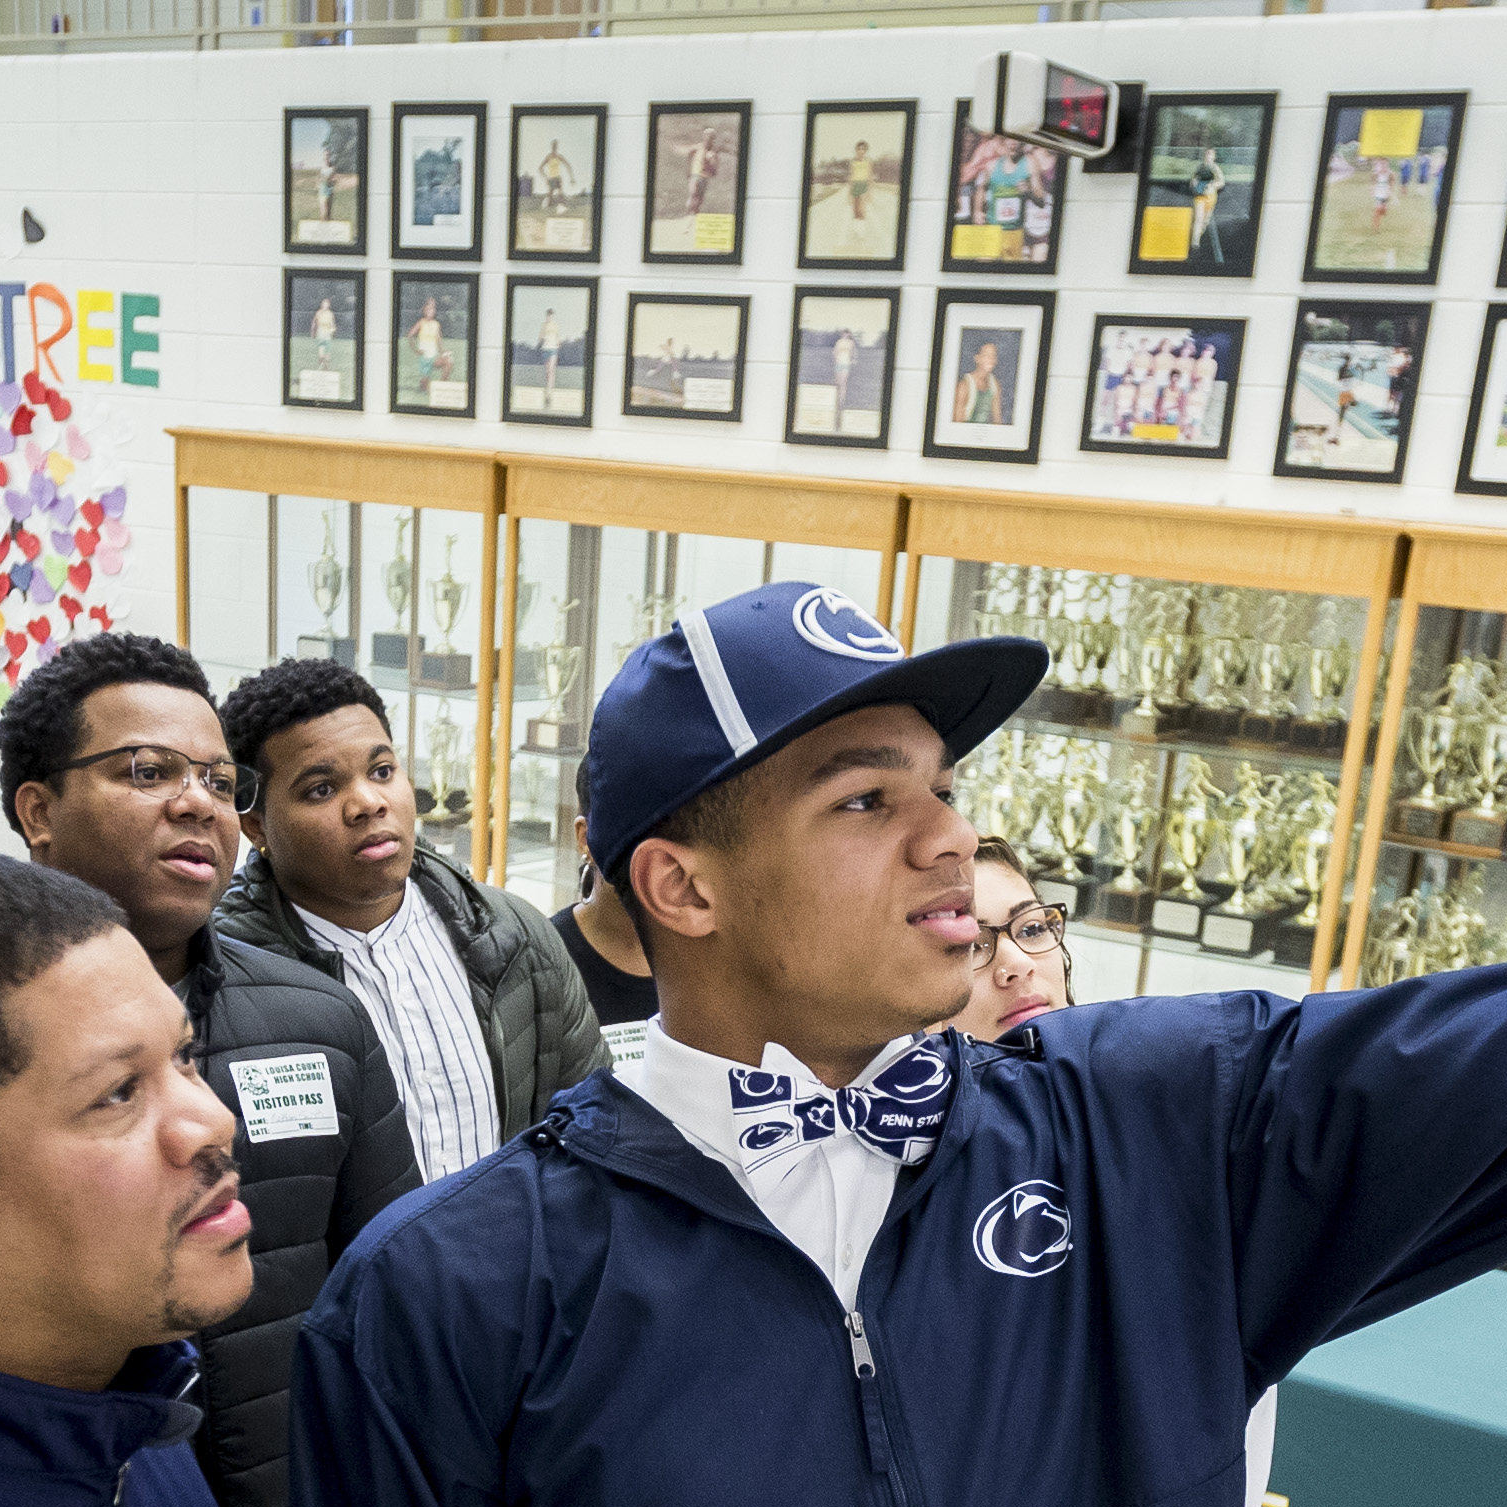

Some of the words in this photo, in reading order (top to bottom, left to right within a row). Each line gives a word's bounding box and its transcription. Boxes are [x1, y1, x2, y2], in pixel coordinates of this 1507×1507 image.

[265, 1064, 294, 1075] LOUISA
[296, 1062, 325, 1072] COUNTY
[273, 1075, 294, 1084] HIGH
[295, 1072, 325, 1082] SCHOOL
[253, 1094, 297, 1110] VISITOR
[299, 1093, 323, 1105] PASS
[879, 1113, 913, 1127] PENN
[916, 1110, 945, 1127] STAT
